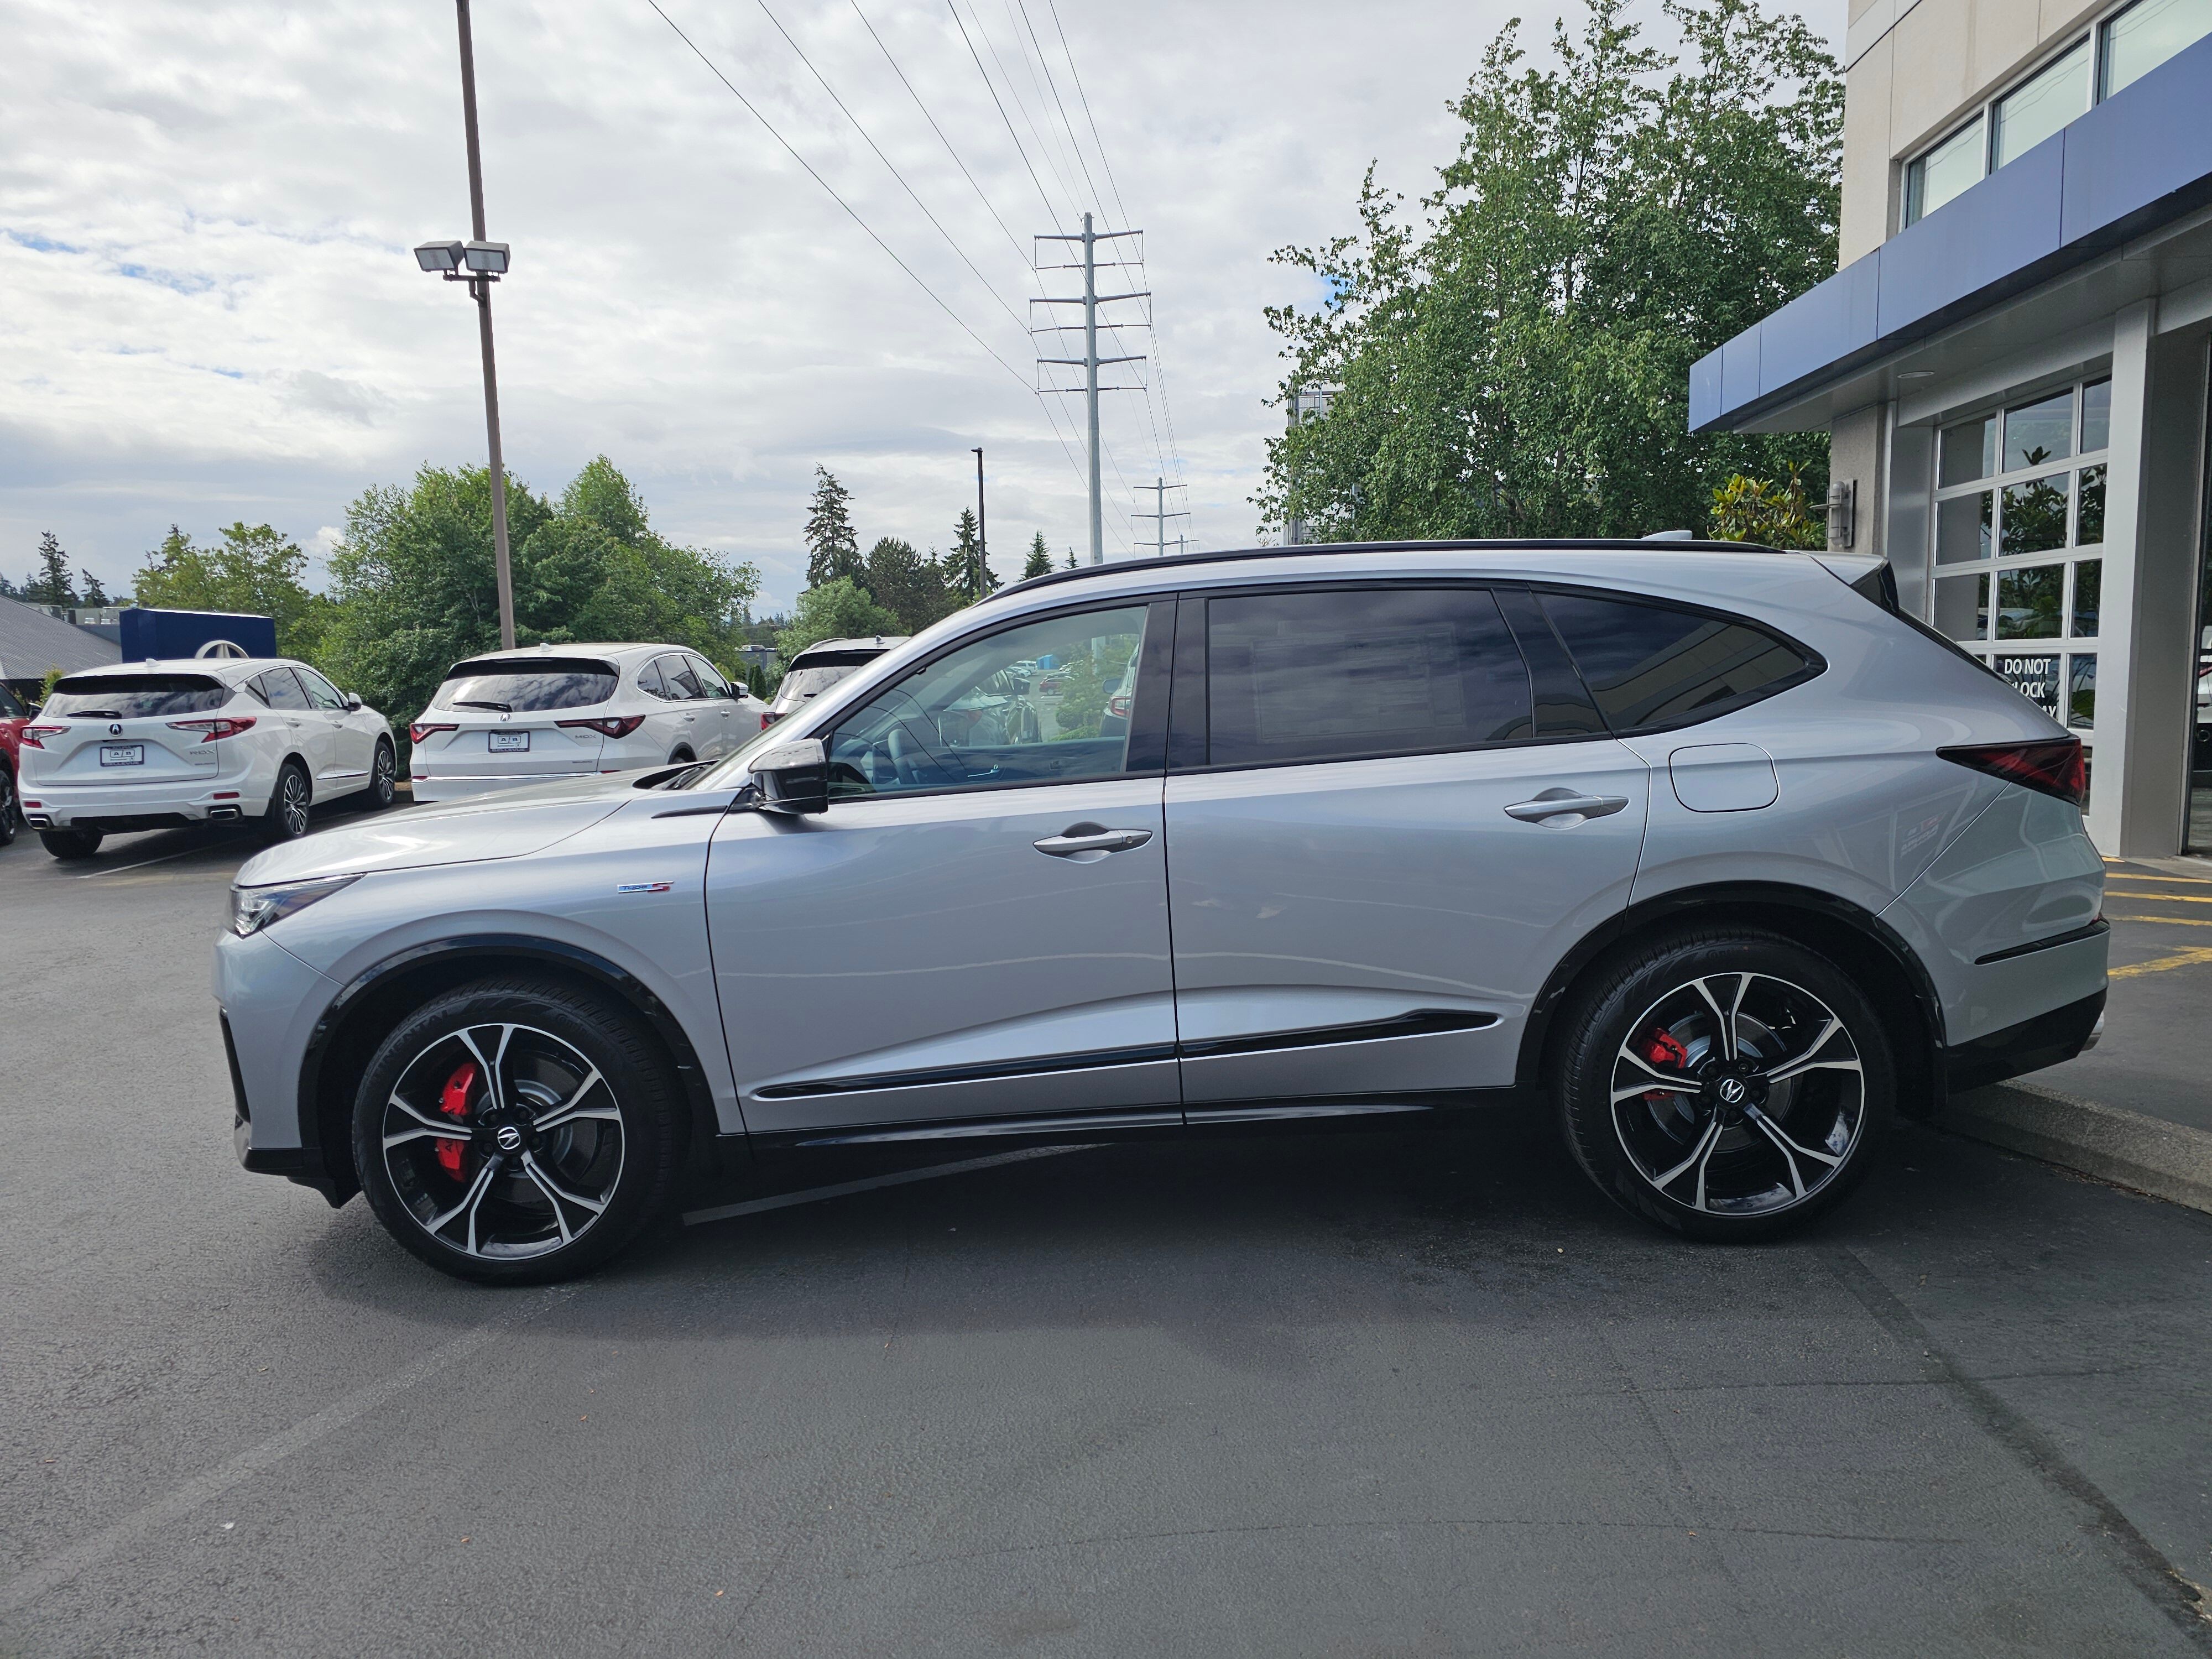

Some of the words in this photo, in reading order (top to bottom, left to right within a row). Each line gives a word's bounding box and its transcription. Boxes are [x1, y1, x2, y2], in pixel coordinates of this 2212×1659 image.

[2005, 659, 2022, 674] DO
[2025, 659, 2051, 674] NOT
[2012, 682, 2046, 698] OCK
[648, 883, 671, 894] S
